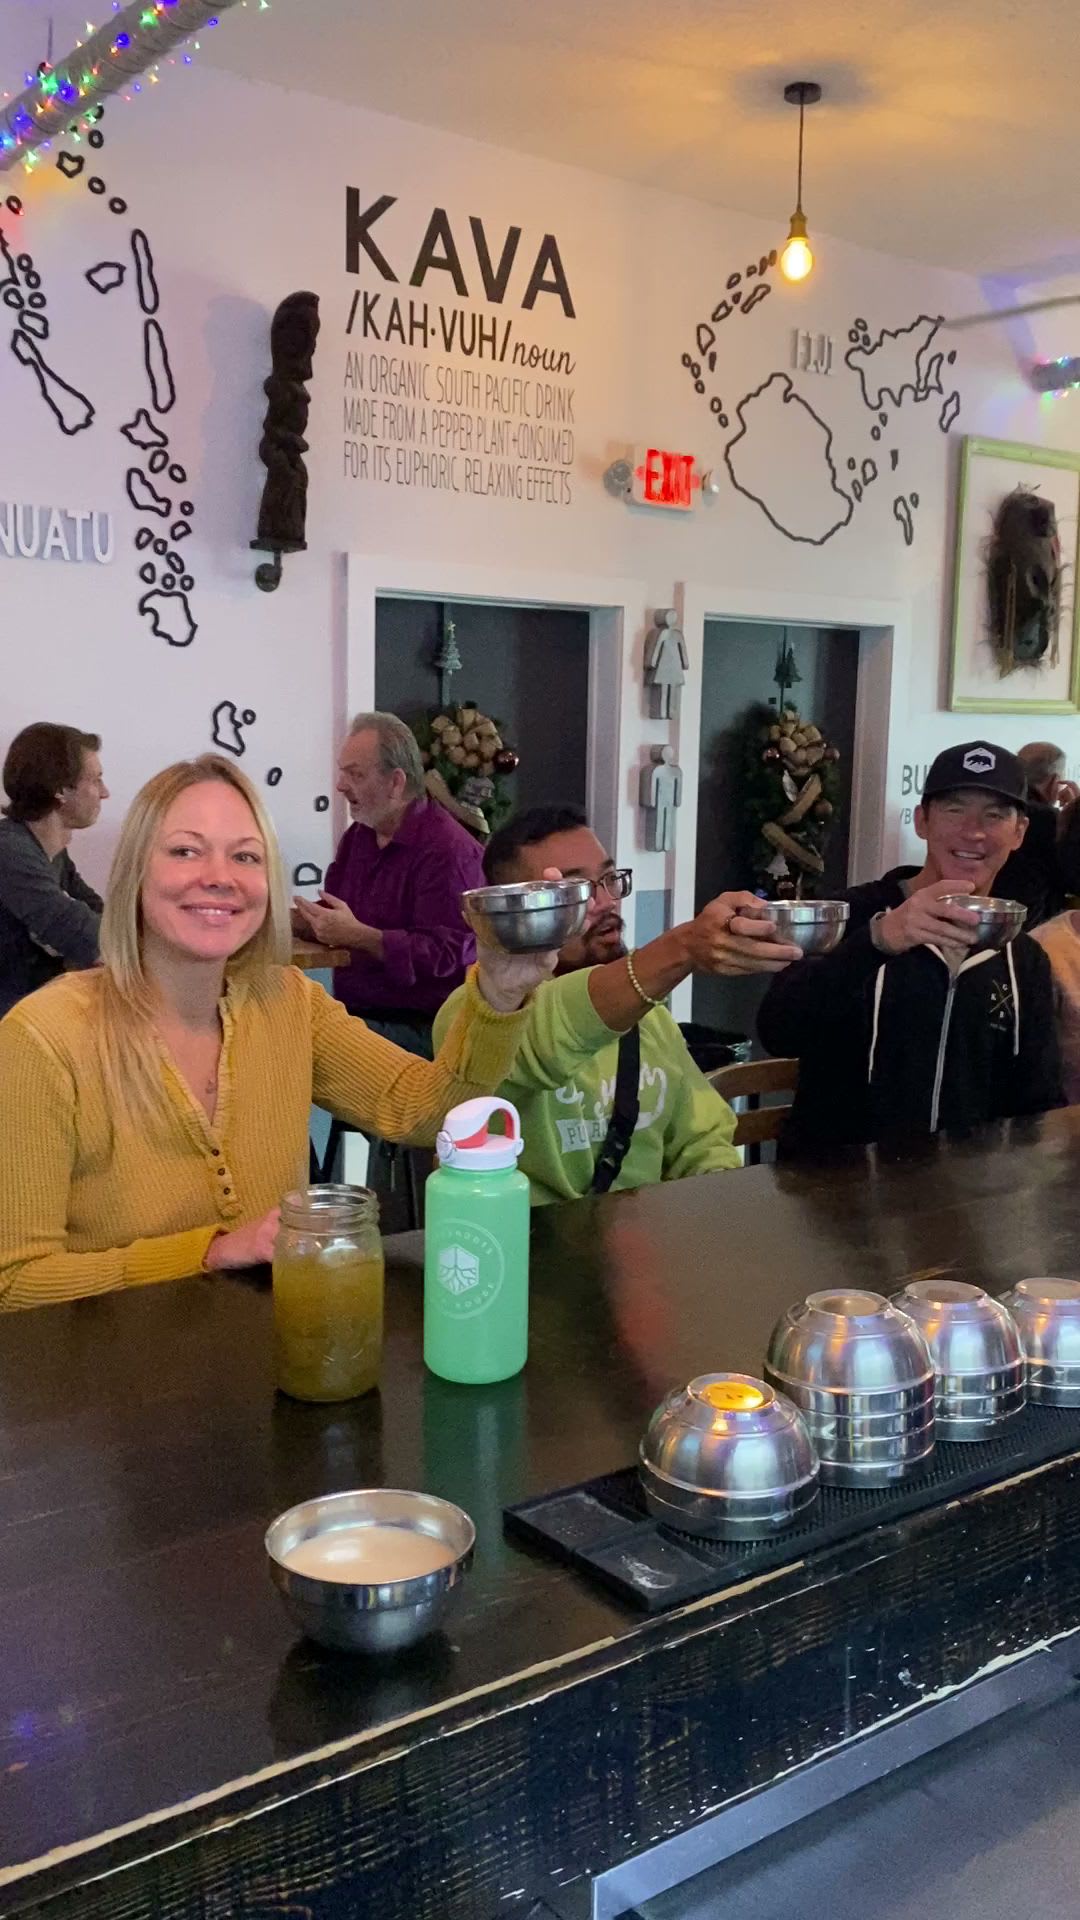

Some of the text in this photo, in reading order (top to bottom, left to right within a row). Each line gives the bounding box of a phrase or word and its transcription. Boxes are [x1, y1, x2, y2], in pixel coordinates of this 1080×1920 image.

[346, 186, 576, 319] KAVA
[344, 351, 575, 424] AN ORGANIC SOUTH PACIFIC DRINK
[511, 341, 576, 375] noun
[343, 396, 378, 438] MADE
[382, 401, 416, 444] FROM
[420, 407, 428, 445] A
[432, 409, 472, 451] PEPPER
[344, 440, 368, 480] FOR
[373, 445, 391, 482] ITS
[465, 458, 522, 500] RELAXING
[526, 466, 571, 505] EFFECTS
[645, 448, 694, 506] EXIT
